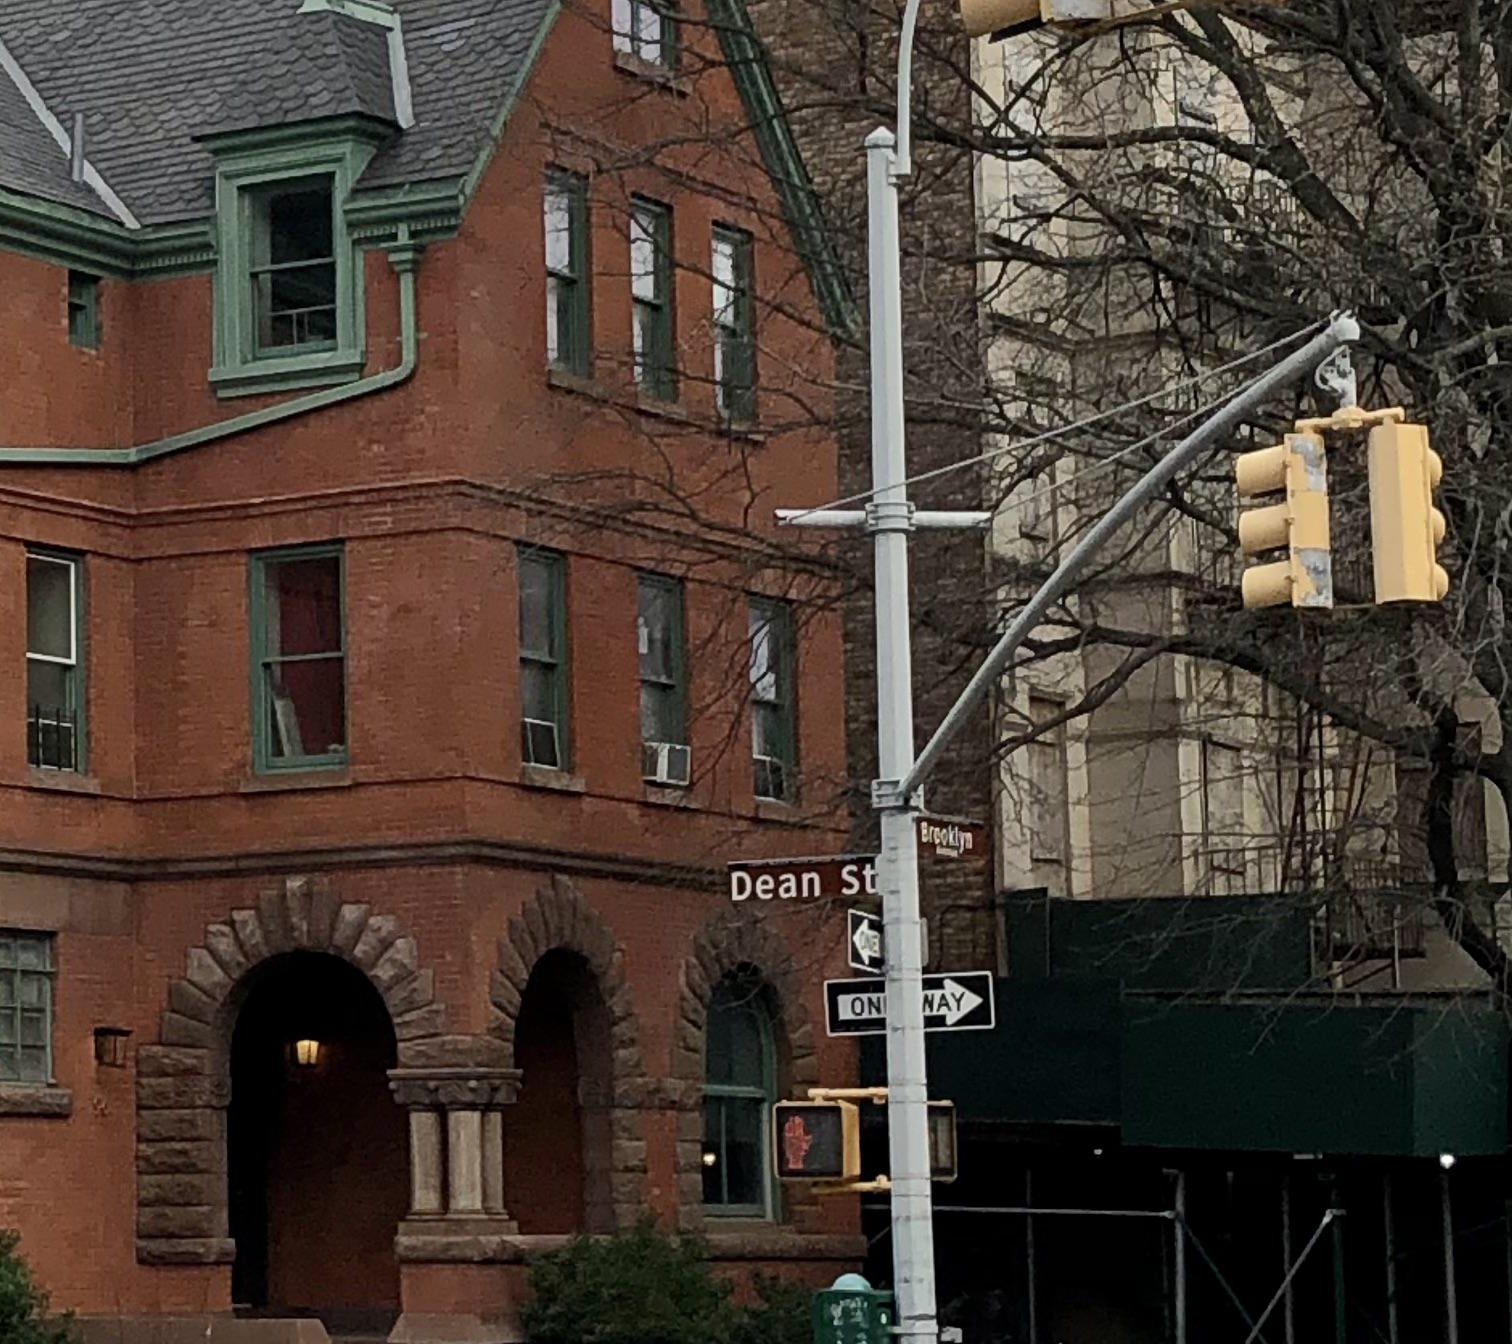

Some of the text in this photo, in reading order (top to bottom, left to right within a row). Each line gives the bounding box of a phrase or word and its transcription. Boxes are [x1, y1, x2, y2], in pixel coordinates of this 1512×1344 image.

[920, 821, 973, 854] Brooklyn
[731, 863, 878, 901] Dean St
[851, 994, 887, 1017] ON
